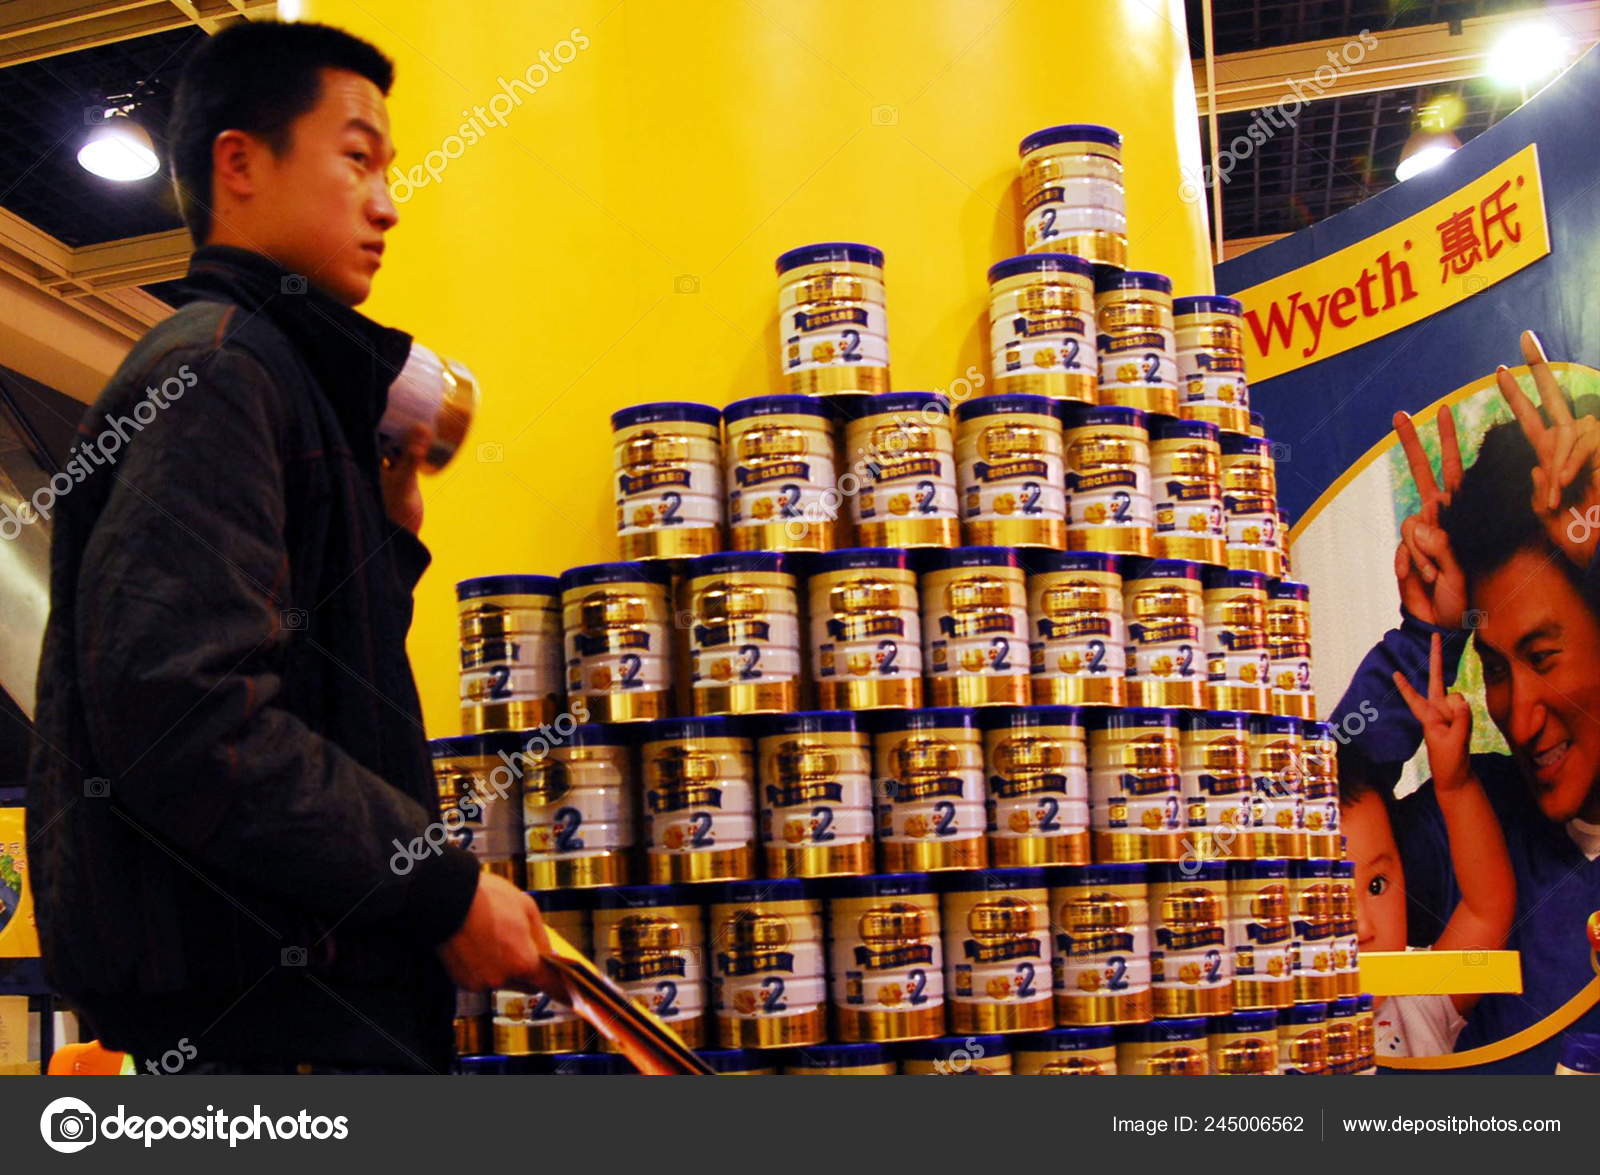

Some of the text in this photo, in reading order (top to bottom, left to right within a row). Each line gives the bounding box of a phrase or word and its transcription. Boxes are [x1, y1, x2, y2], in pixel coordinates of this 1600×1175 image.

[1041, 208, 1060, 237] 2
[1244, 180, 1522, 358] Wyeth 惠氏
[841, 330, 862, 362] 2
[1063, 338, 1081, 369] 2
[1144, 353, 1162, 382] 2
[661, 492, 684, 525] 2
[917, 481, 938, 514] 2
[1022, 482, 1042, 515] 2
[1113, 491, 1132, 523] 2
[738, 644, 762, 681] 2
[879, 640, 899, 674] 2
[991, 637, 1011, 671] 2
[1088, 640, 1107, 673] 2
[1178, 644, 1195, 676] 2
[489, 665, 512, 700] 2
[620, 654, 643, 689] 2
[554, 807, 584, 852] 2
[689, 812, 714, 848] 2
[811, 807, 834, 842] 2
[934, 802, 957, 836] 2
[1038, 798, 1060, 832] 2
[908, 969, 928, 1005] 2
[1016, 963, 1036, 997] 2
[1107, 956, 1128, 990] 2
[656, 981, 679, 1017] 2
[762, 977, 787, 1013] 2
